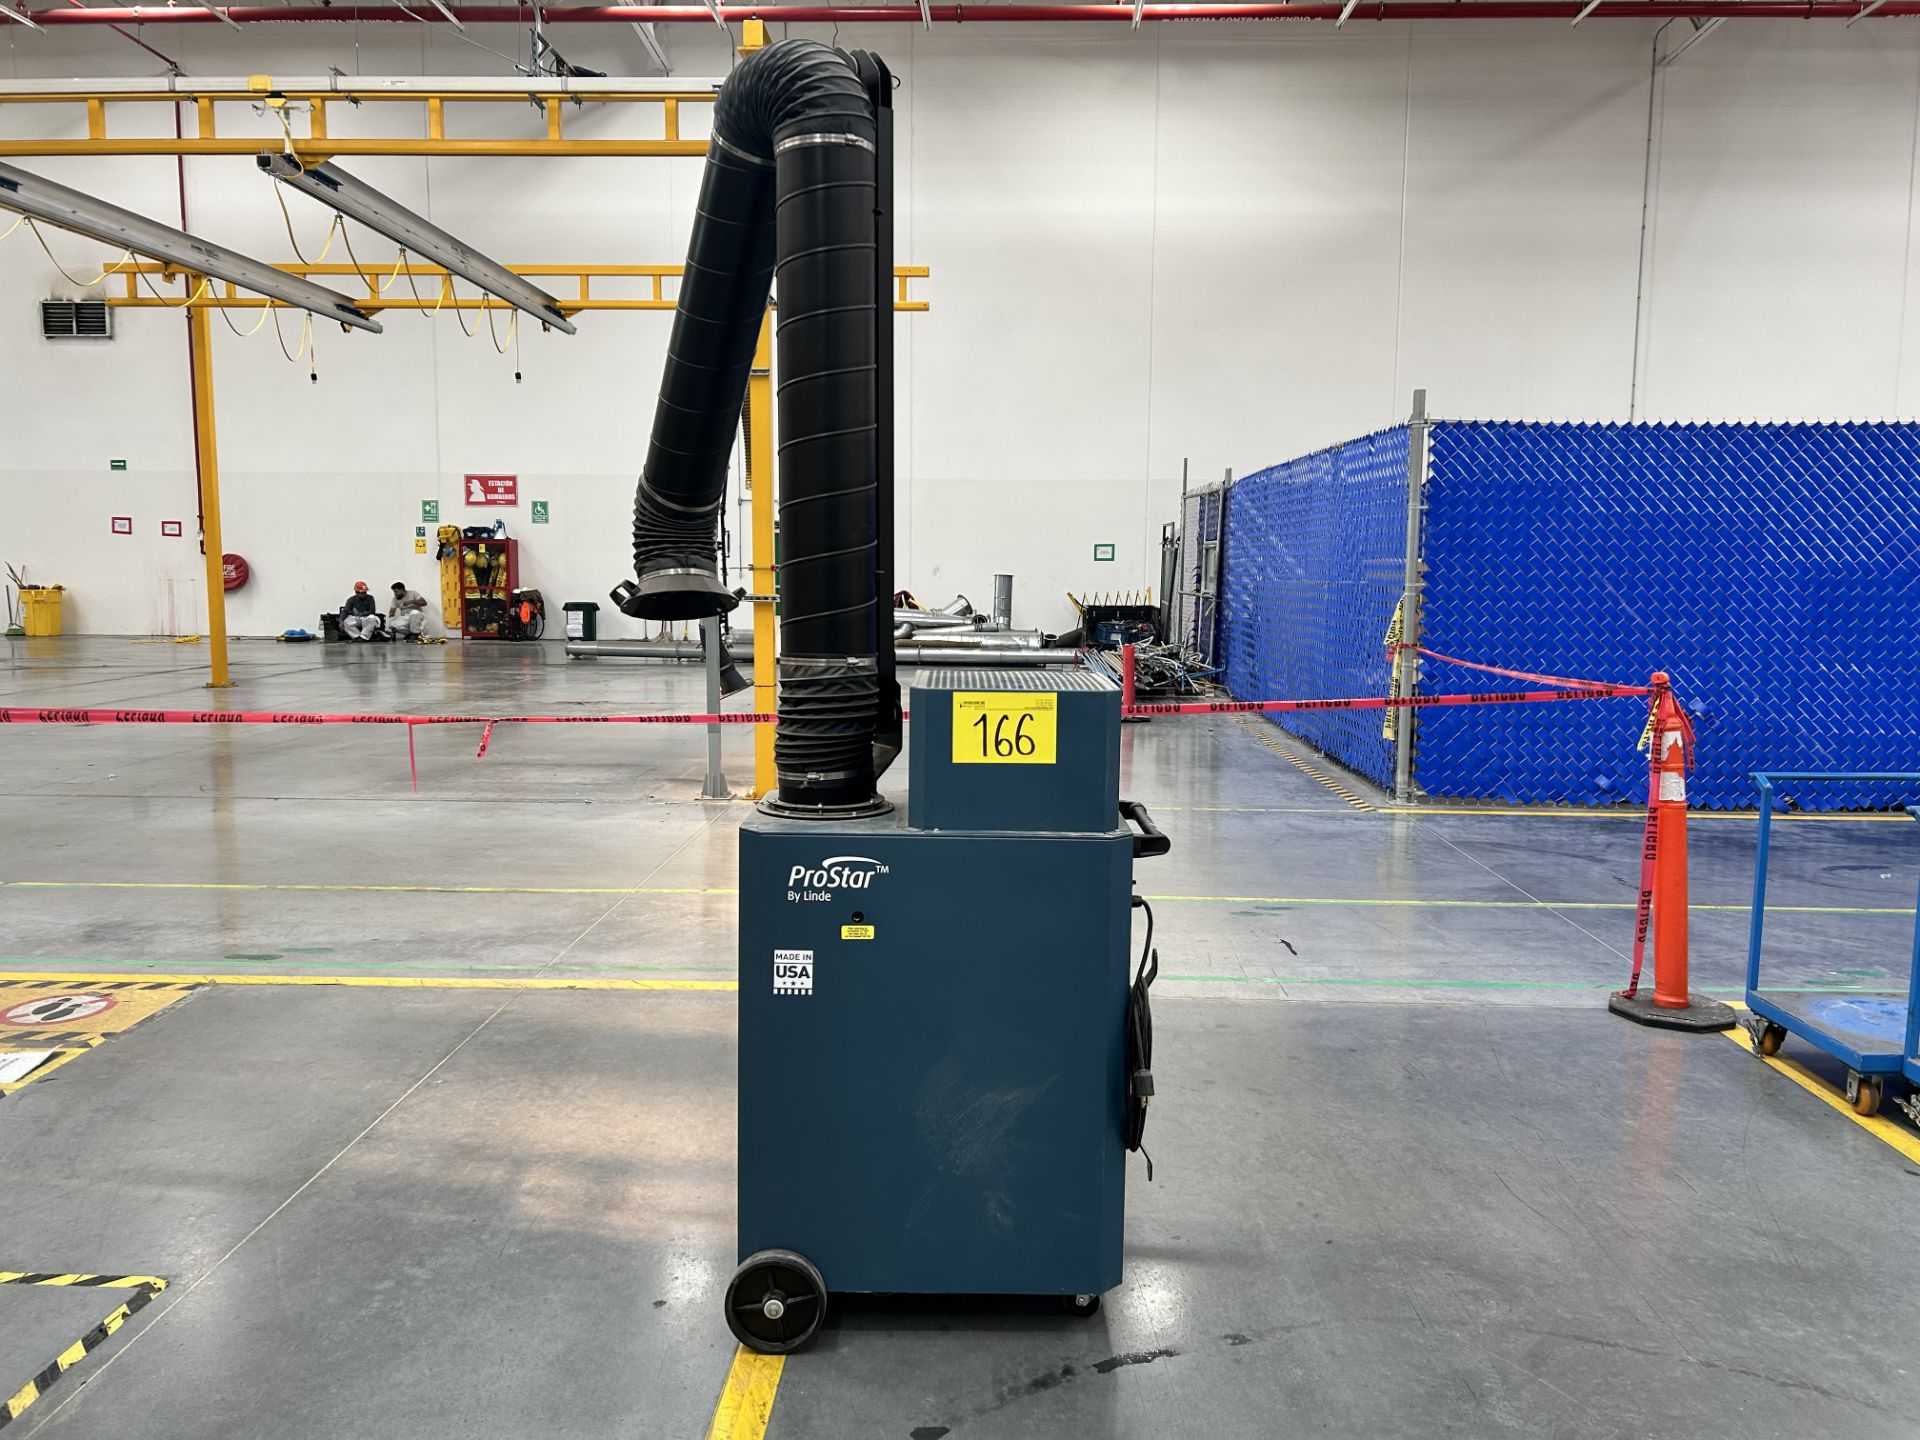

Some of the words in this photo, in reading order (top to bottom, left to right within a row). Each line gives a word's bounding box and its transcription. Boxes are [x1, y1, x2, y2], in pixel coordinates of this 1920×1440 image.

[973, 713, 1035, 757] 166
[787, 890, 801, 903] By
[803, 890, 832, 902] Linde
[775, 965, 810, 978] USA
